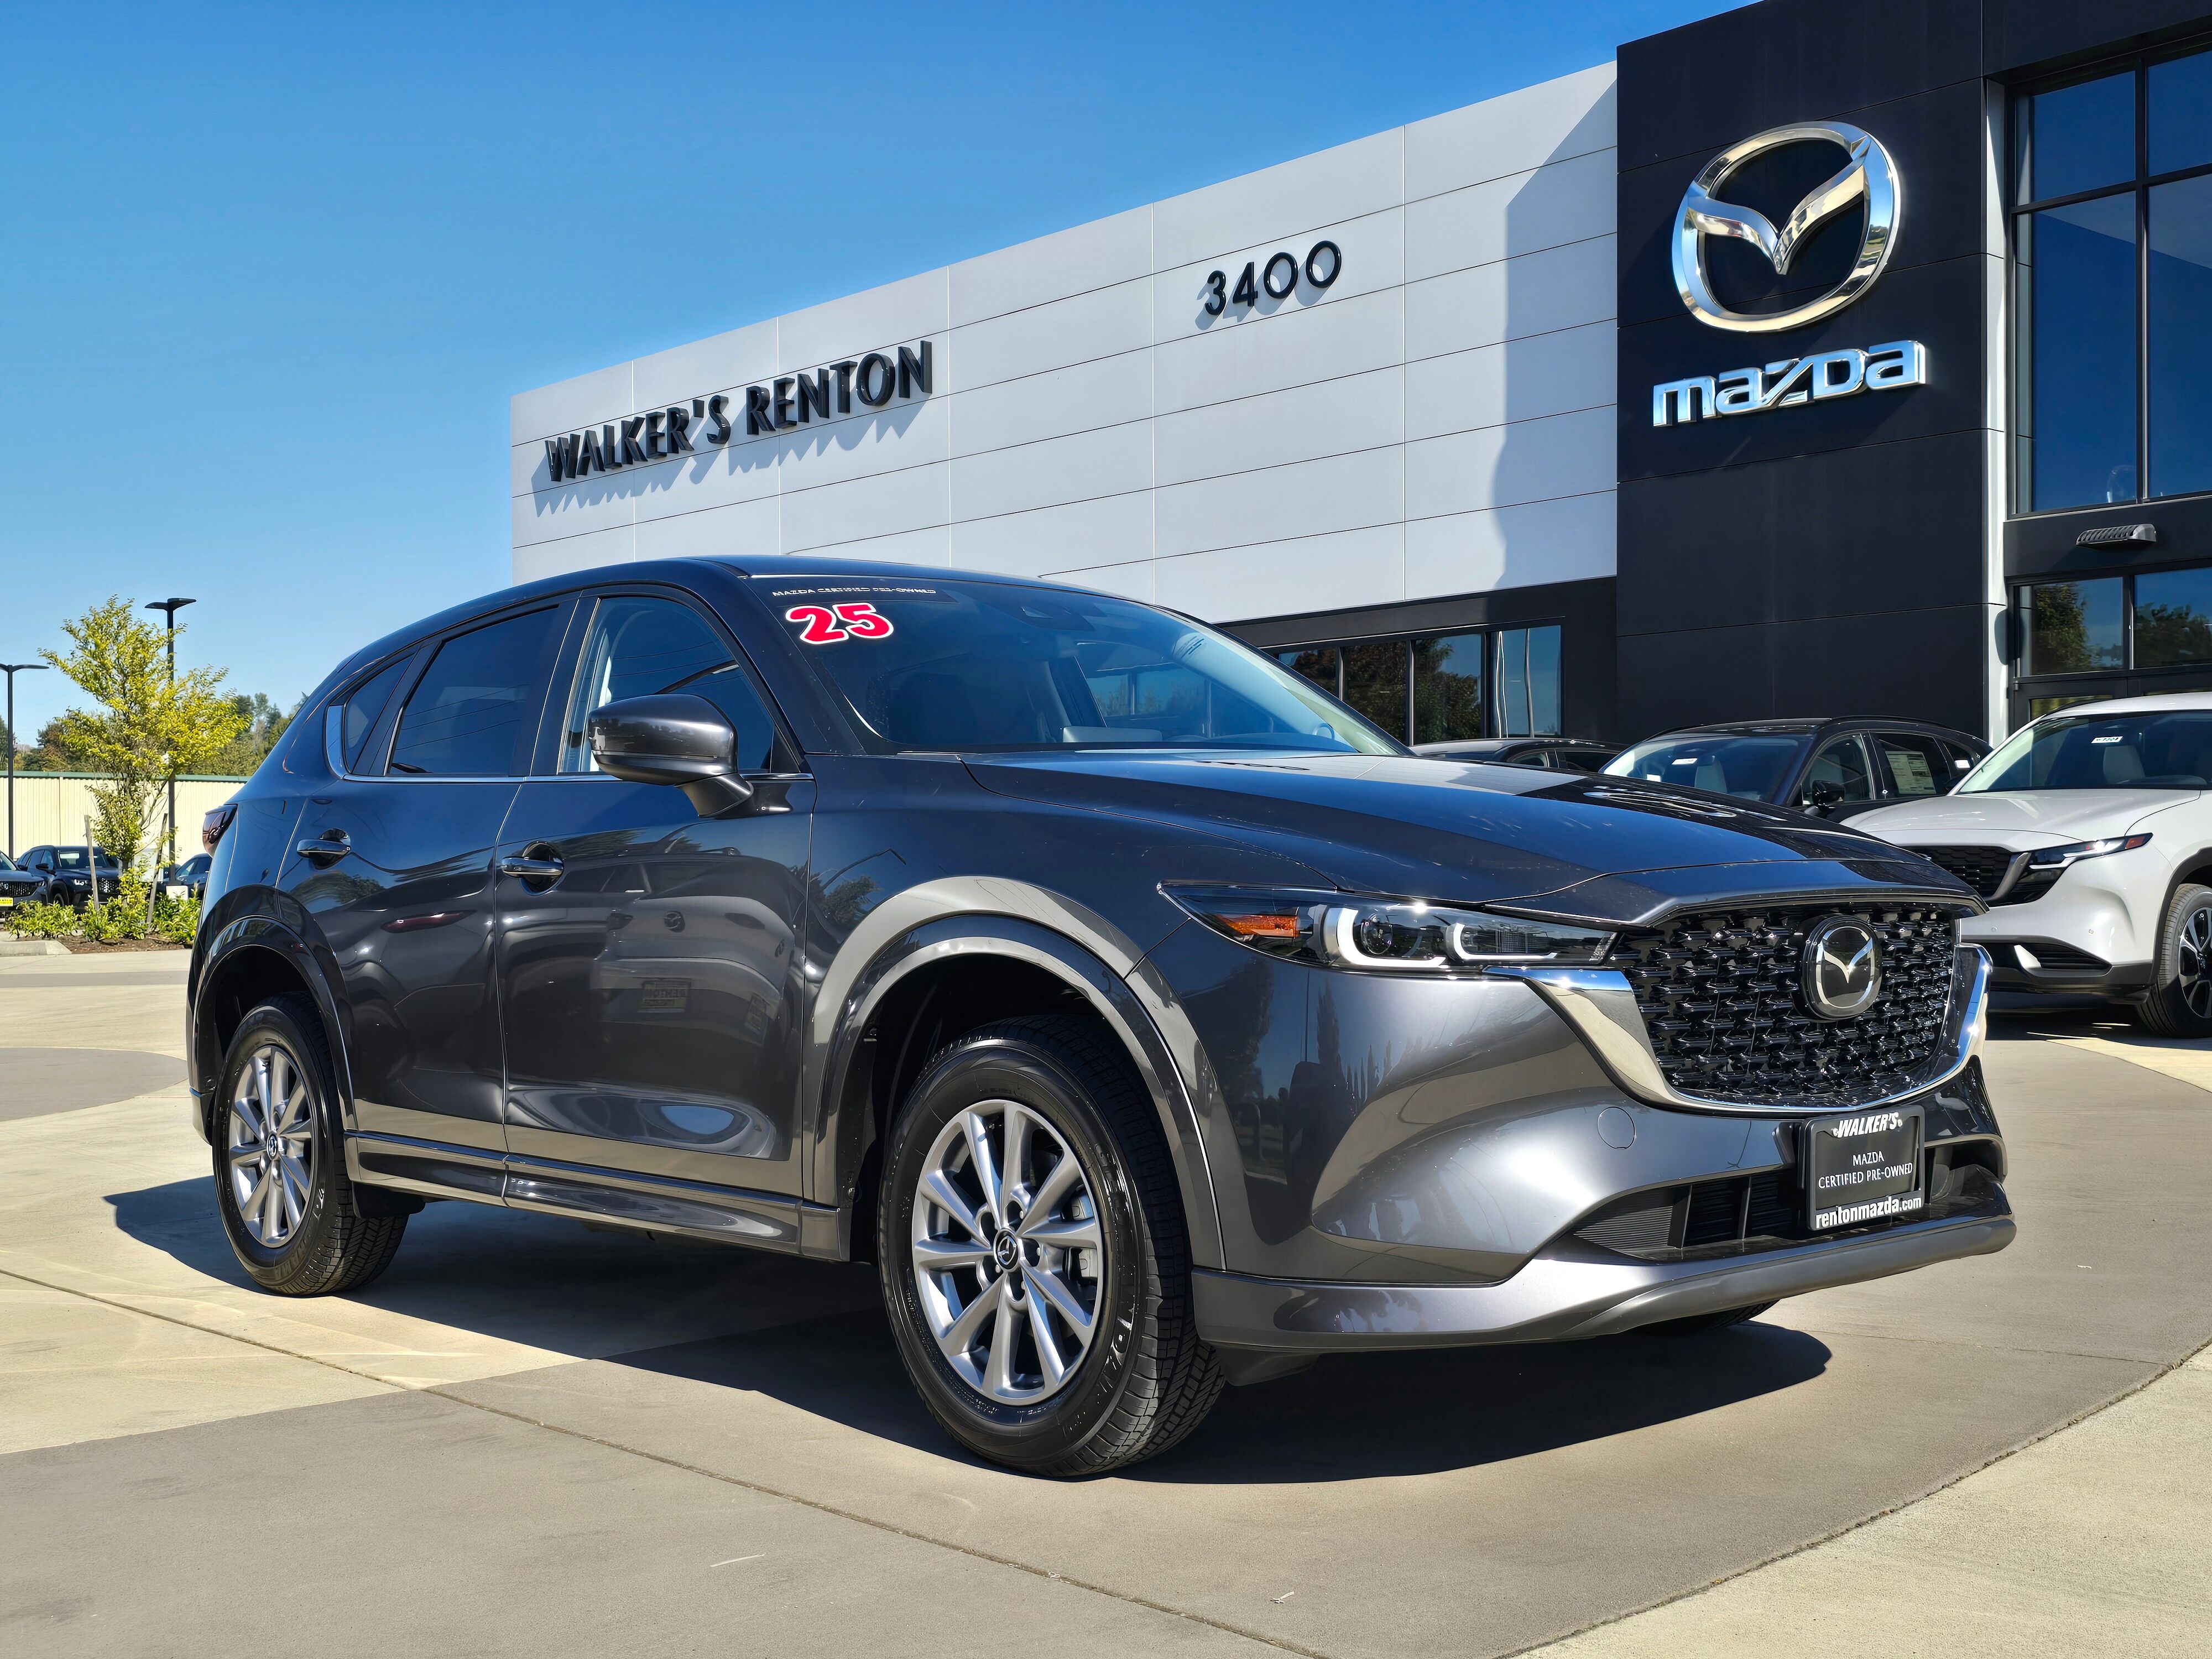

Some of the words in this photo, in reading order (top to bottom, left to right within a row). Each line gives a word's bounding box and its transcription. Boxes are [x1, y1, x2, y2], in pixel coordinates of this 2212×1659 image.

[1204, 240, 1342, 315] 3400
[1653, 339, 1926, 427] mazda
[544, 394, 731, 482] WALKER'S
[745, 340, 933, 435] RENTON
[785, 602, 894, 644] 25
[1837, 1112, 1900, 1138] WALKER'S
[1818, 1171, 1864, 1188] CERTIFIED
[1866, 1162, 1913, 1182] PRE-OWNED
[1853, 1151, 1885, 1166] MAZDA
[1815, 1196, 1922, 1229] rentonmazda.com
